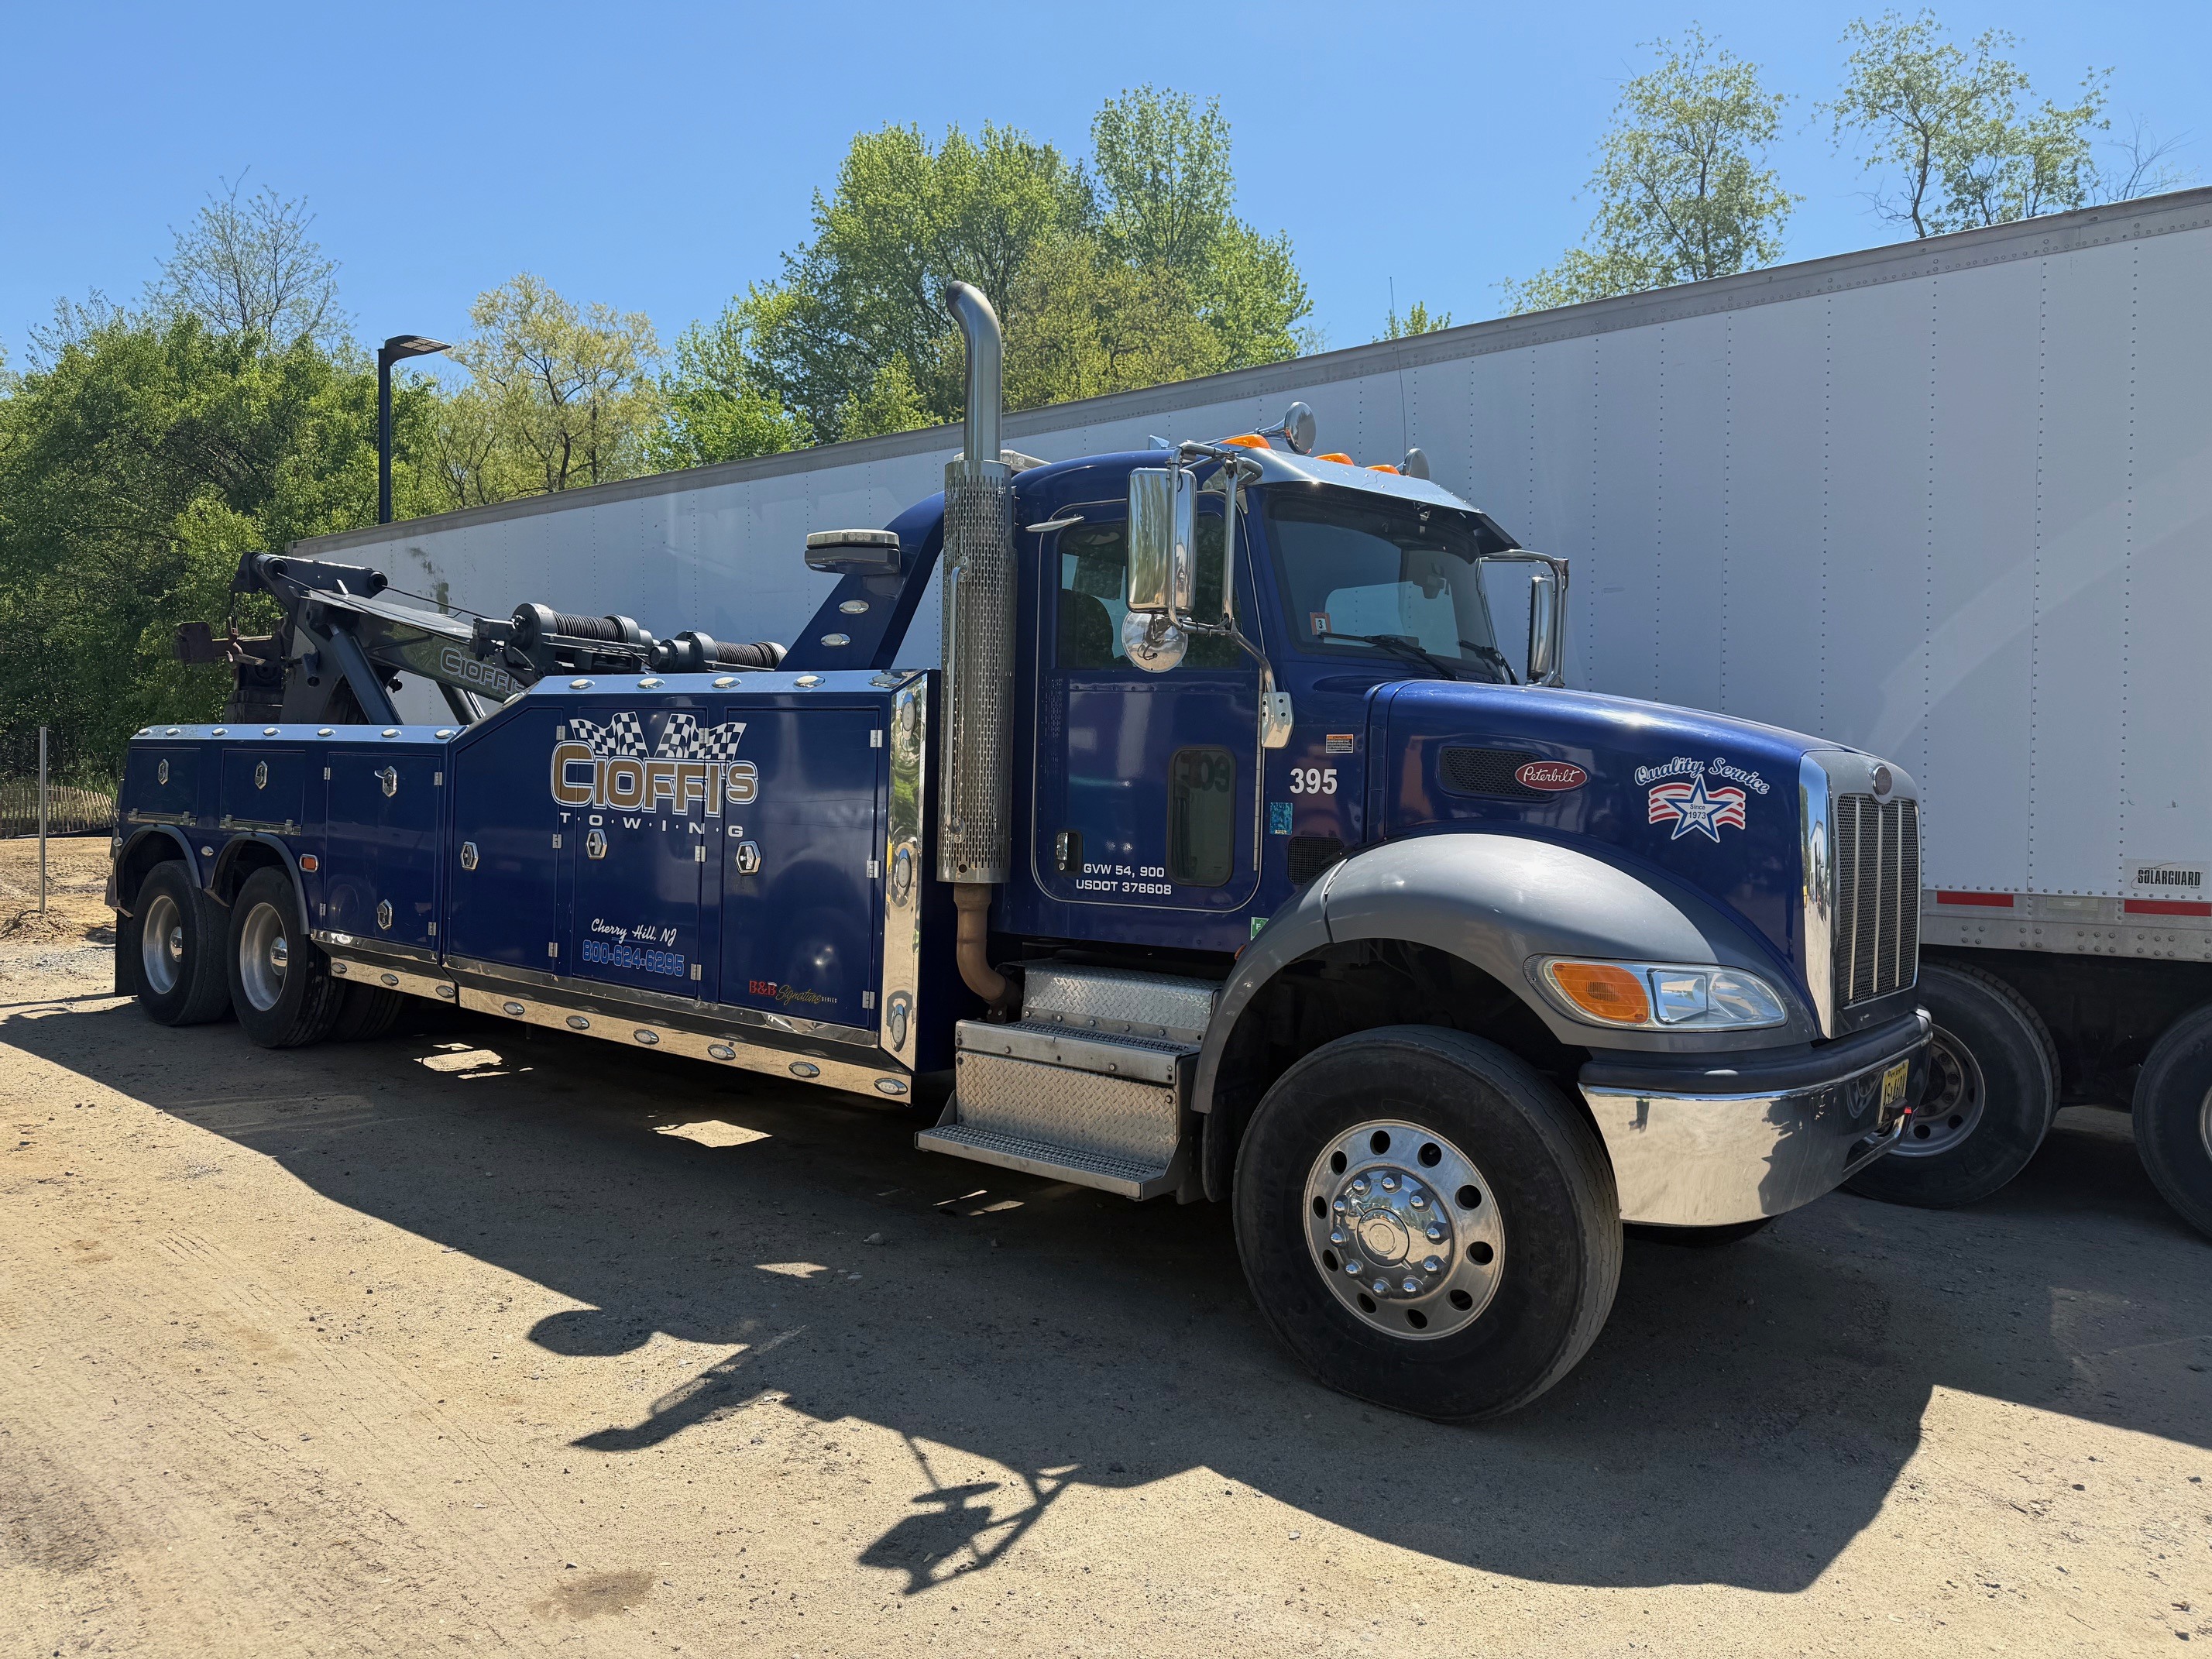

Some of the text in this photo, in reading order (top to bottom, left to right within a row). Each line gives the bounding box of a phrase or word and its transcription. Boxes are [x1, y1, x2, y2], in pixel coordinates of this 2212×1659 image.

[1318, 620, 1323, 629] 3
[1290, 768, 1338, 795] 395
[1523, 766, 1581, 782] Peterbilt
[1634, 756, 1771, 795] Quality Service
[1688, 811, 1706, 819] 1973
[1084, 863, 1165, 878] GVW 54, 900
[2138, 869, 2201, 886] SOLARGUARD
[1076, 878, 1172, 895] USDOT 378608
[591, 918, 678, 946] Cherry Hill, NJ
[582, 939, 685, 977] 800-624-6295
[749, 980, 777, 997] B&B
[775, 984, 821, 1005] Signature
